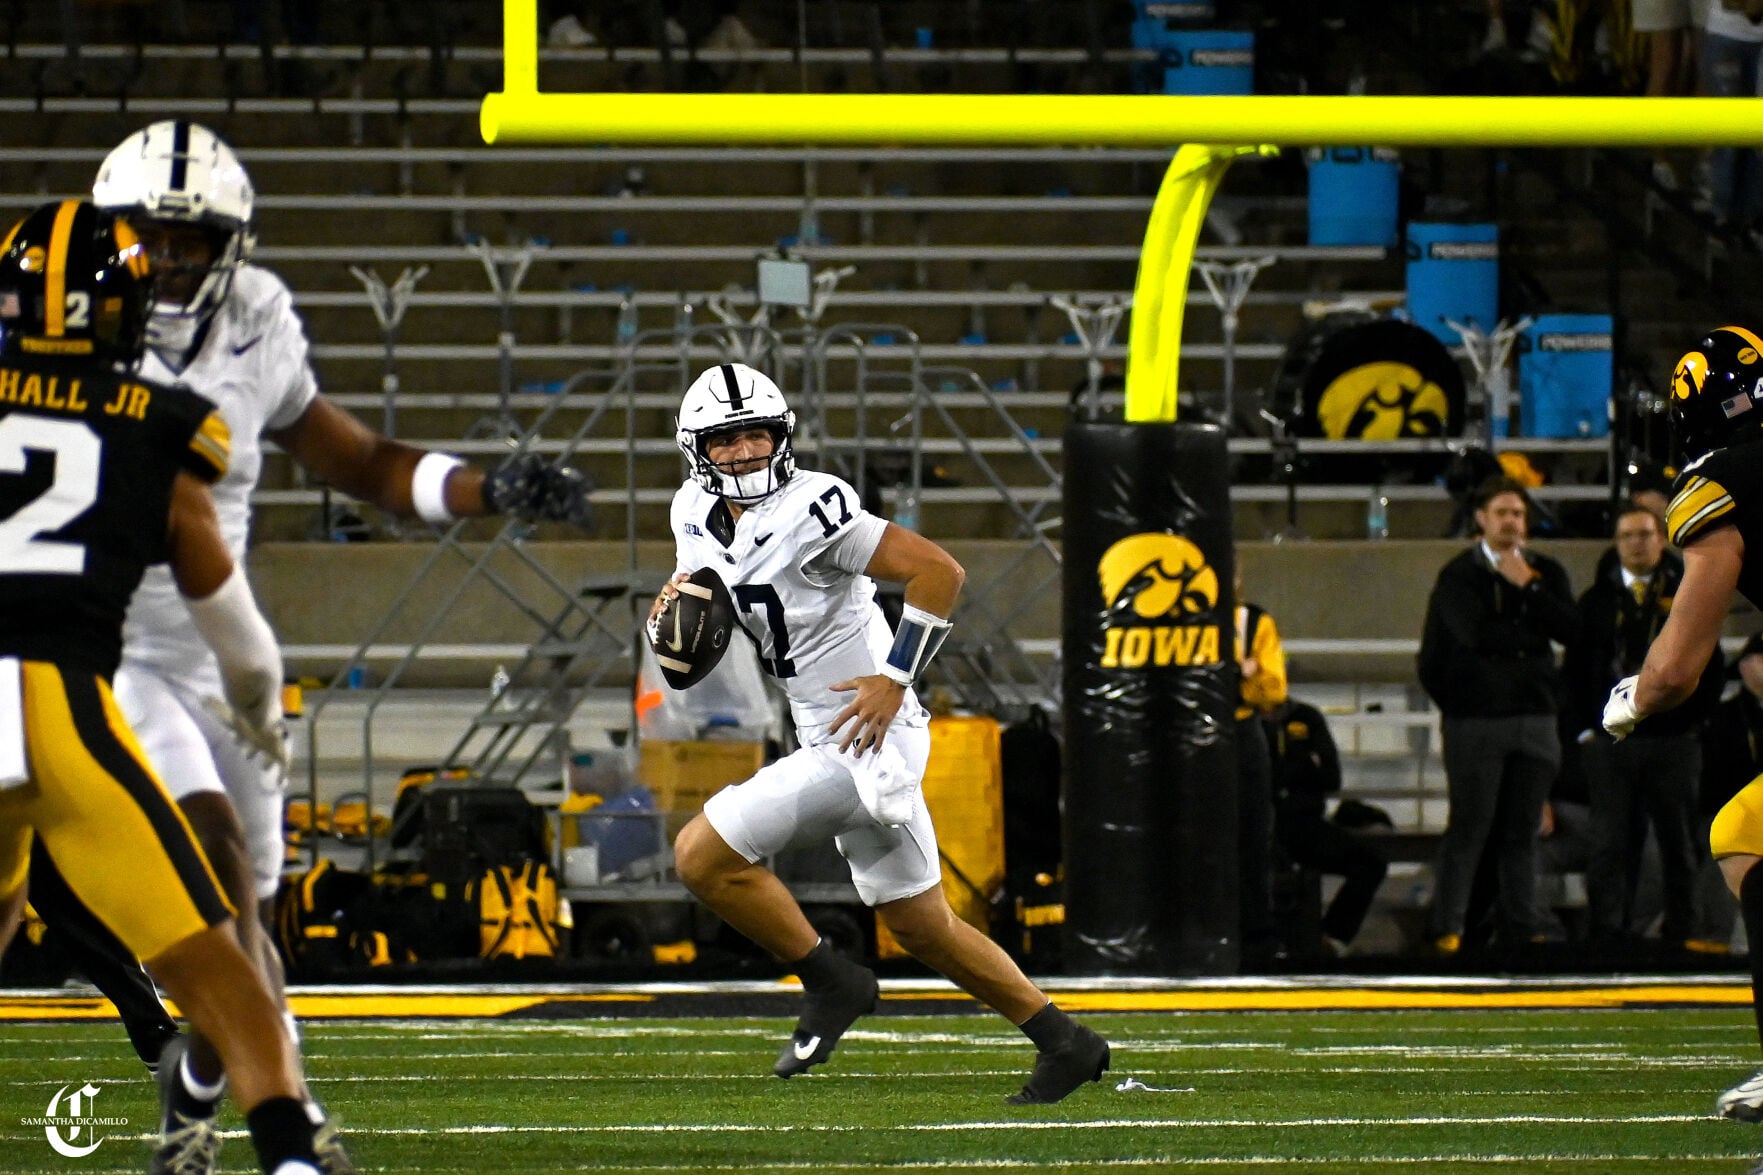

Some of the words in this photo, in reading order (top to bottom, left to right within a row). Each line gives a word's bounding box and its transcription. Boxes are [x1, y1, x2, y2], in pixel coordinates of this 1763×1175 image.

[66, 290, 89, 329] 2
[0, 367, 88, 413] HALL
[103, 382, 151, 421] JR
[0, 412, 102, 575] 2
[808, 485, 853, 539] 17
[1101, 625, 1220, 668] IOWA
